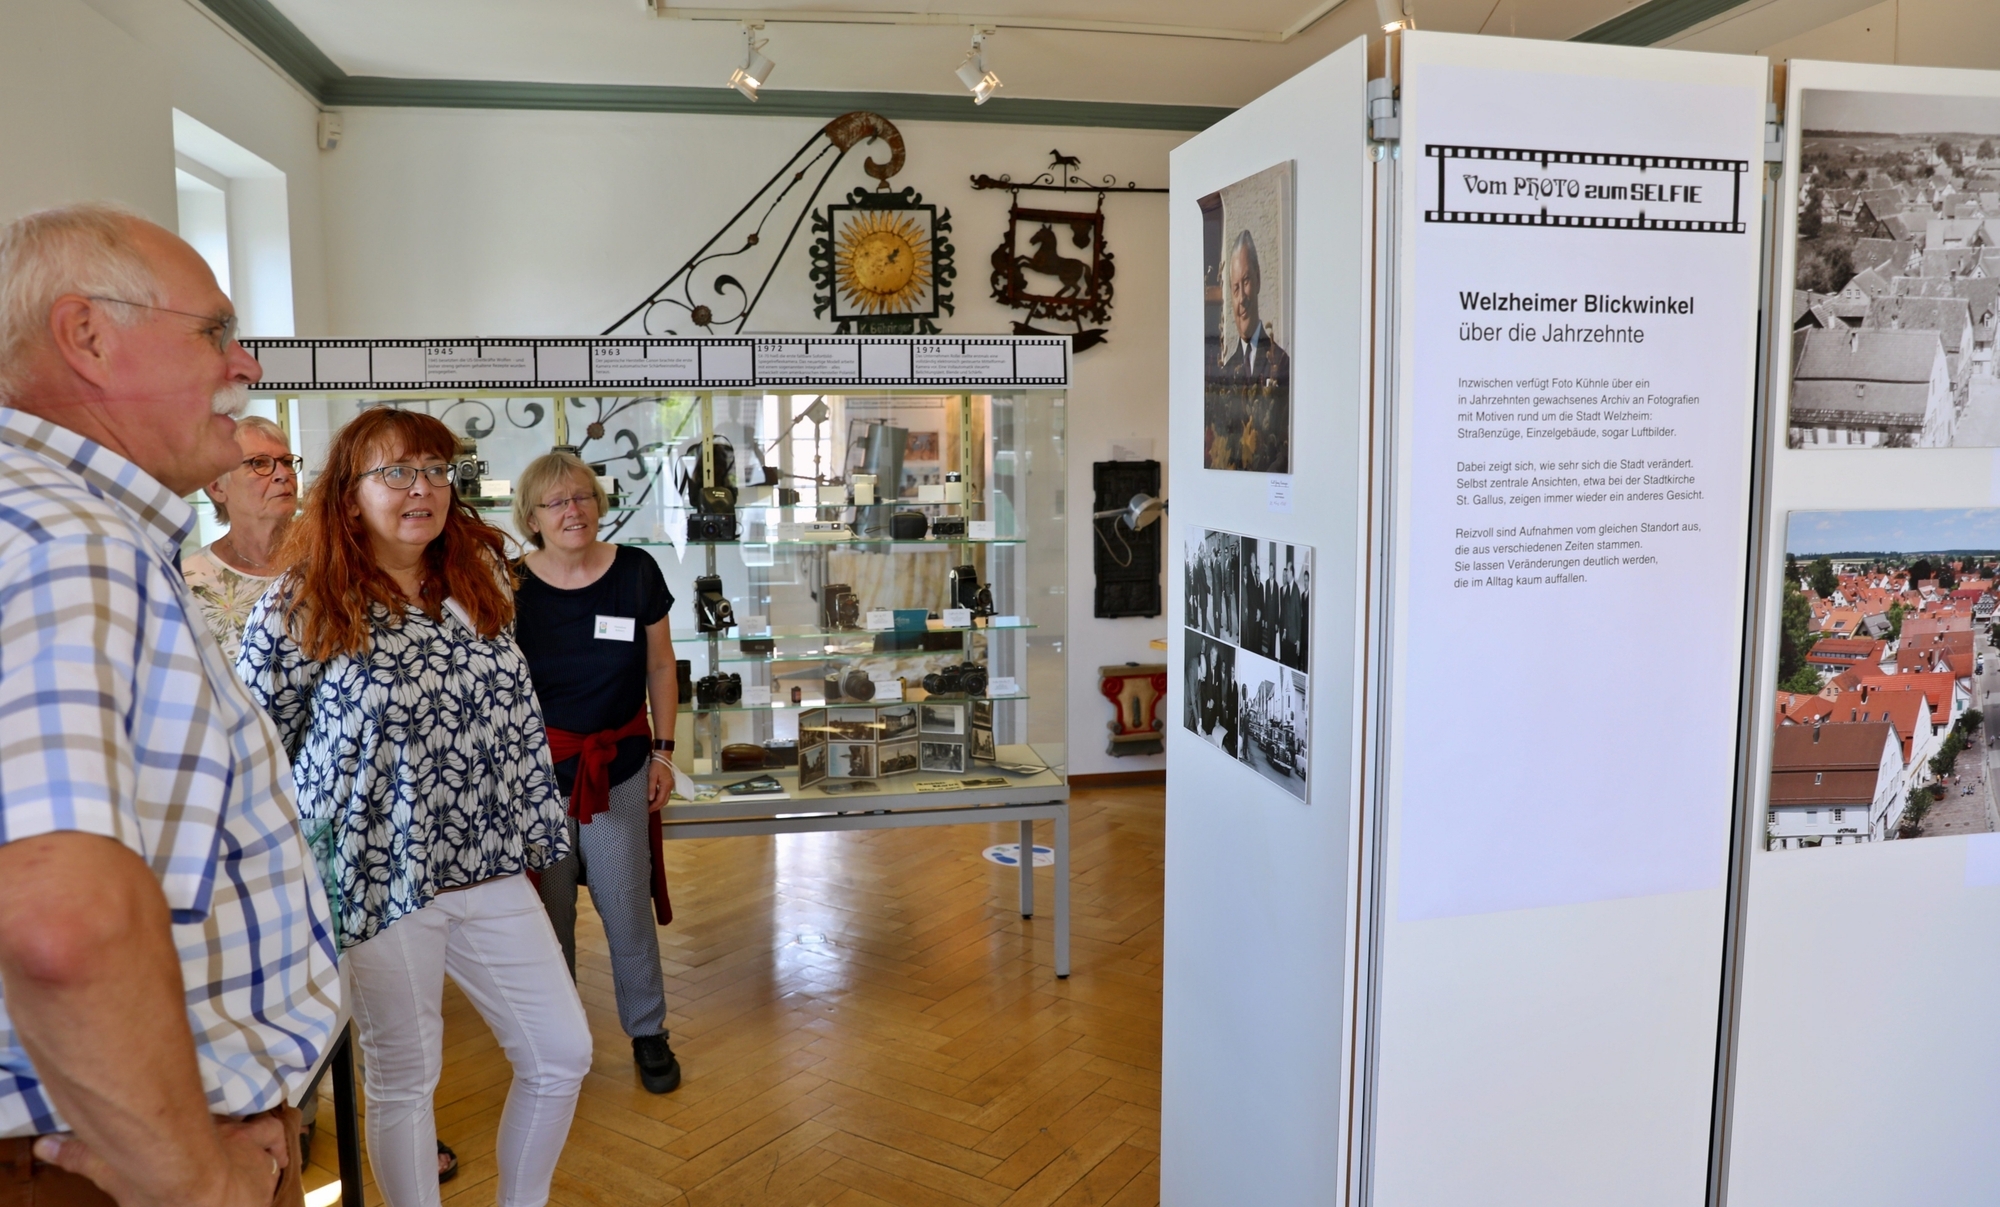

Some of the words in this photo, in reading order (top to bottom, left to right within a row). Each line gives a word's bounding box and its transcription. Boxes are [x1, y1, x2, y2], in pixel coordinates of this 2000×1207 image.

[1463, 174, 1507, 195] Vom
[1513, 177, 1580, 200] PHOTO
[1585, 184, 1627, 200] zum
[1630, 183, 1703, 204] SELFIE
[1459, 291, 1578, 313] Welzheimer
[1584, 294, 1694, 315] Blickwinkel
[1459, 323, 1502, 341] über
[1508, 323, 1536, 342] die
[1542, 324, 1645, 343] Jahrzehnte
[595, 348, 621, 356] 1963
[1458, 378, 1513, 388] Inzwischen
[1516, 378, 1549, 391] verfügt
[1552, 378, 1573, 388] Foto
[1576, 378, 1609, 388] Kühnle
[1612, 378, 1633, 388] über
[1635, 379, 1650, 388] ein
[1458, 395, 1467, 404] in
[1469, 395, 1530, 405] Jahrzehnten
[1533, 395, 1598, 407] gewachsenes
[1600, 395, 1630, 404] Archiv
[1647, 394, 1699, 407] Fotografien
[1458, 412, 1473, 421] mit
[1476, 411, 1514, 421] Motiven
[1517, 411, 1539, 421] rund
[1542, 413, 1556, 421] um
[1559, 411, 1573, 421] die
[1576, 411, 1601, 421] Stadt
[1603, 411, 1652, 421] Welzheim:
[1457, 428, 1523, 441] Straßenzüge,
[1527, 427, 1599, 441] Einzelgebäude,
[1602, 429, 1629, 439] sogar
[1631, 427, 1676, 437] Luftbilder.
[1457, 461, 1486, 472] Dabei
[1488, 461, 1512, 474] zeigt
[1515, 461, 1536, 472] sich,
[1539, 461, 1556, 470] wie
[1558, 460, 1579, 470] sehr
[1581, 460, 1600, 470] sich
[1603, 460, 1617, 469] die
[1620, 459, 1644, 469] Stadt
[1647, 459, 1693, 468] verändert.
[1457, 478, 1487, 489] Selbst
[1490, 477, 1529, 488] zentrale
[1531, 477, 1580, 488] Ansichten,
[1583, 477, 1605, 486] etwa
[1608, 475, 1622, 485] bei
[1625, 475, 1641, 485] der
[1643, 474, 1695, 485] Stadtkirche
[1456, 495, 1469, 505] St.
[1473, 494, 1506, 506] Gallus,
[1509, 494, 1541, 506] zeigen
[1544, 493, 1573, 503] immer
[1576, 492, 1607, 502] wieder
[1610, 492, 1624, 501] ein
[1627, 491, 1664, 501] anderes
[1666, 490, 1704, 500] Gesicht.
[1456, 527, 1494, 538] Reizvoll
[1496, 527, 1516, 537] sind
[1519, 526, 1573, 536] Aufnahmen
[1576, 526, 1596, 534] vom
[1599, 524, 1638, 536] gleichen
[1641, 522, 1679, 532] Standort
[1682, 523, 1701, 533] aus,
[1455, 545, 1470, 555] die
[1472, 546, 1490, 554] aus
[1493, 542, 1562, 553] verschiedenen
[1565, 541, 1594, 551] Zeiten
[1597, 541, 1642, 550] stammen.
[1455, 561, 1470, 572] Sie
[1473, 561, 1504, 571] lassen
[1507, 558, 1580, 570] Veränderungen
[1583, 556, 1619, 566] deutlich
[1622, 555, 1658, 565] werden,
[1454, 578, 1469, 588] die
[1472, 577, 1483, 587] im
[1486, 576, 1513, 588] Alltag
[1516, 575, 1542, 585] kaum
[1545, 573, 1587, 584] auffallen.
